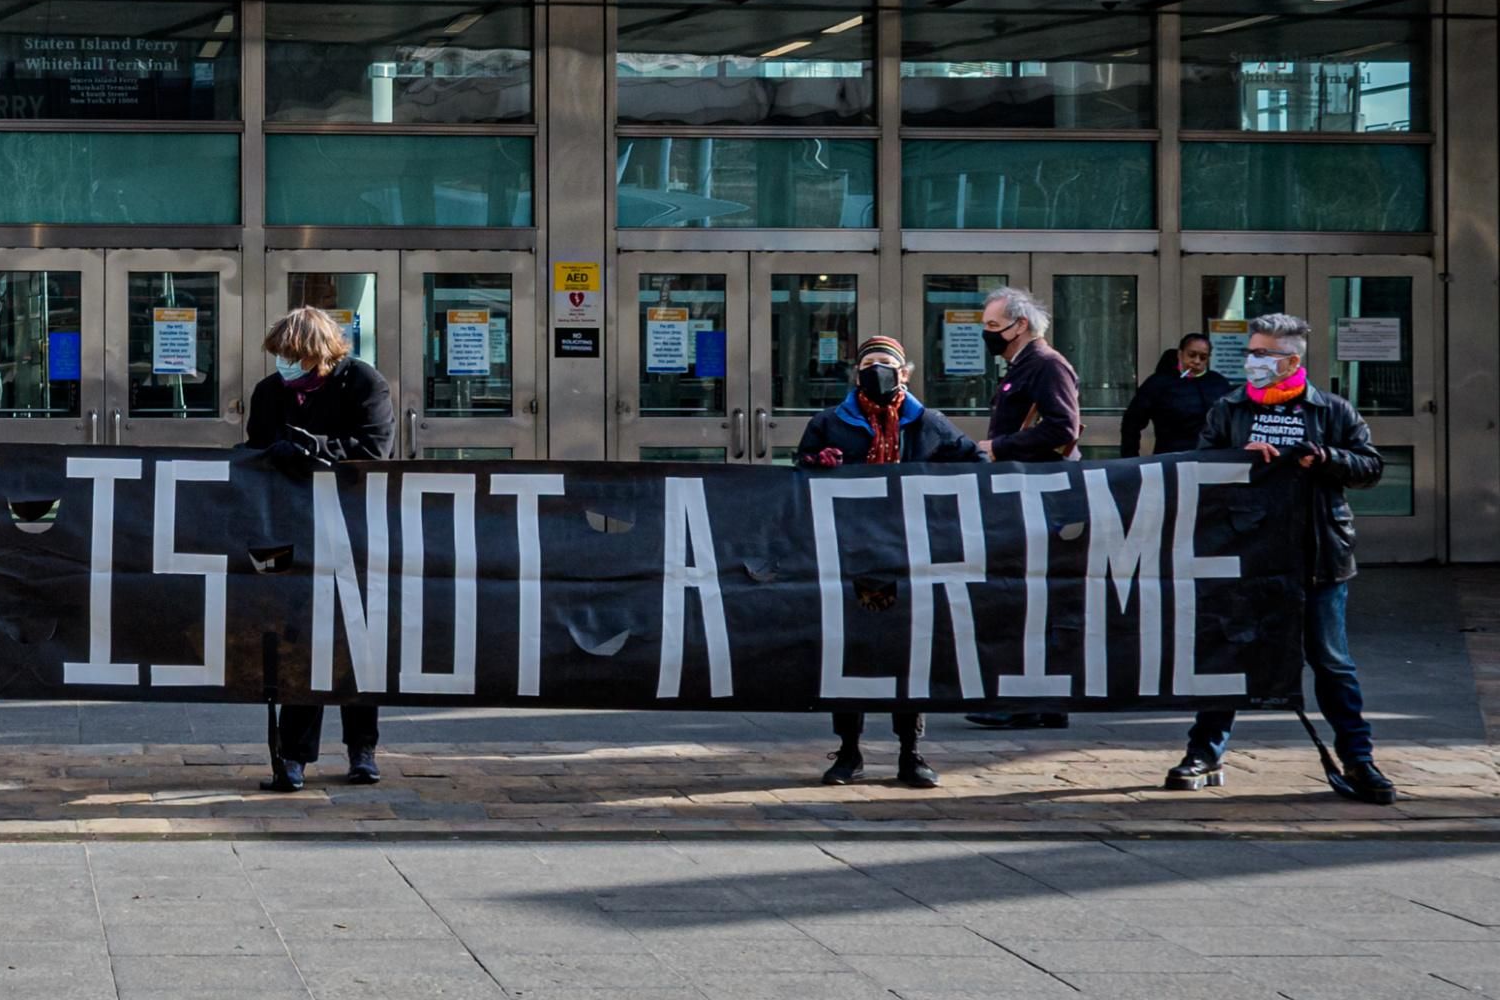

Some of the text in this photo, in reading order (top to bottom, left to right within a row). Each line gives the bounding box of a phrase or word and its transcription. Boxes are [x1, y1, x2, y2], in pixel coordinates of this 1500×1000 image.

[24, 37, 178, 53] Staten Island Ferry
[26, 57, 103, 71] Whitehall
[1308, 71, 1371, 84] Temial
[566, 273, 588, 282] AED
[1259, 414, 1305, 425] RADICAL
[1252, 422, 1305, 435] MAGINATION
[1251, 433, 1267, 442] ETS
[1268, 435, 1280, 444] US
[62, 457, 231, 687] IS
[310, 471, 566, 697] NOT
[655, 476, 734, 698] A
[809, 461, 1251, 699] CRIME
